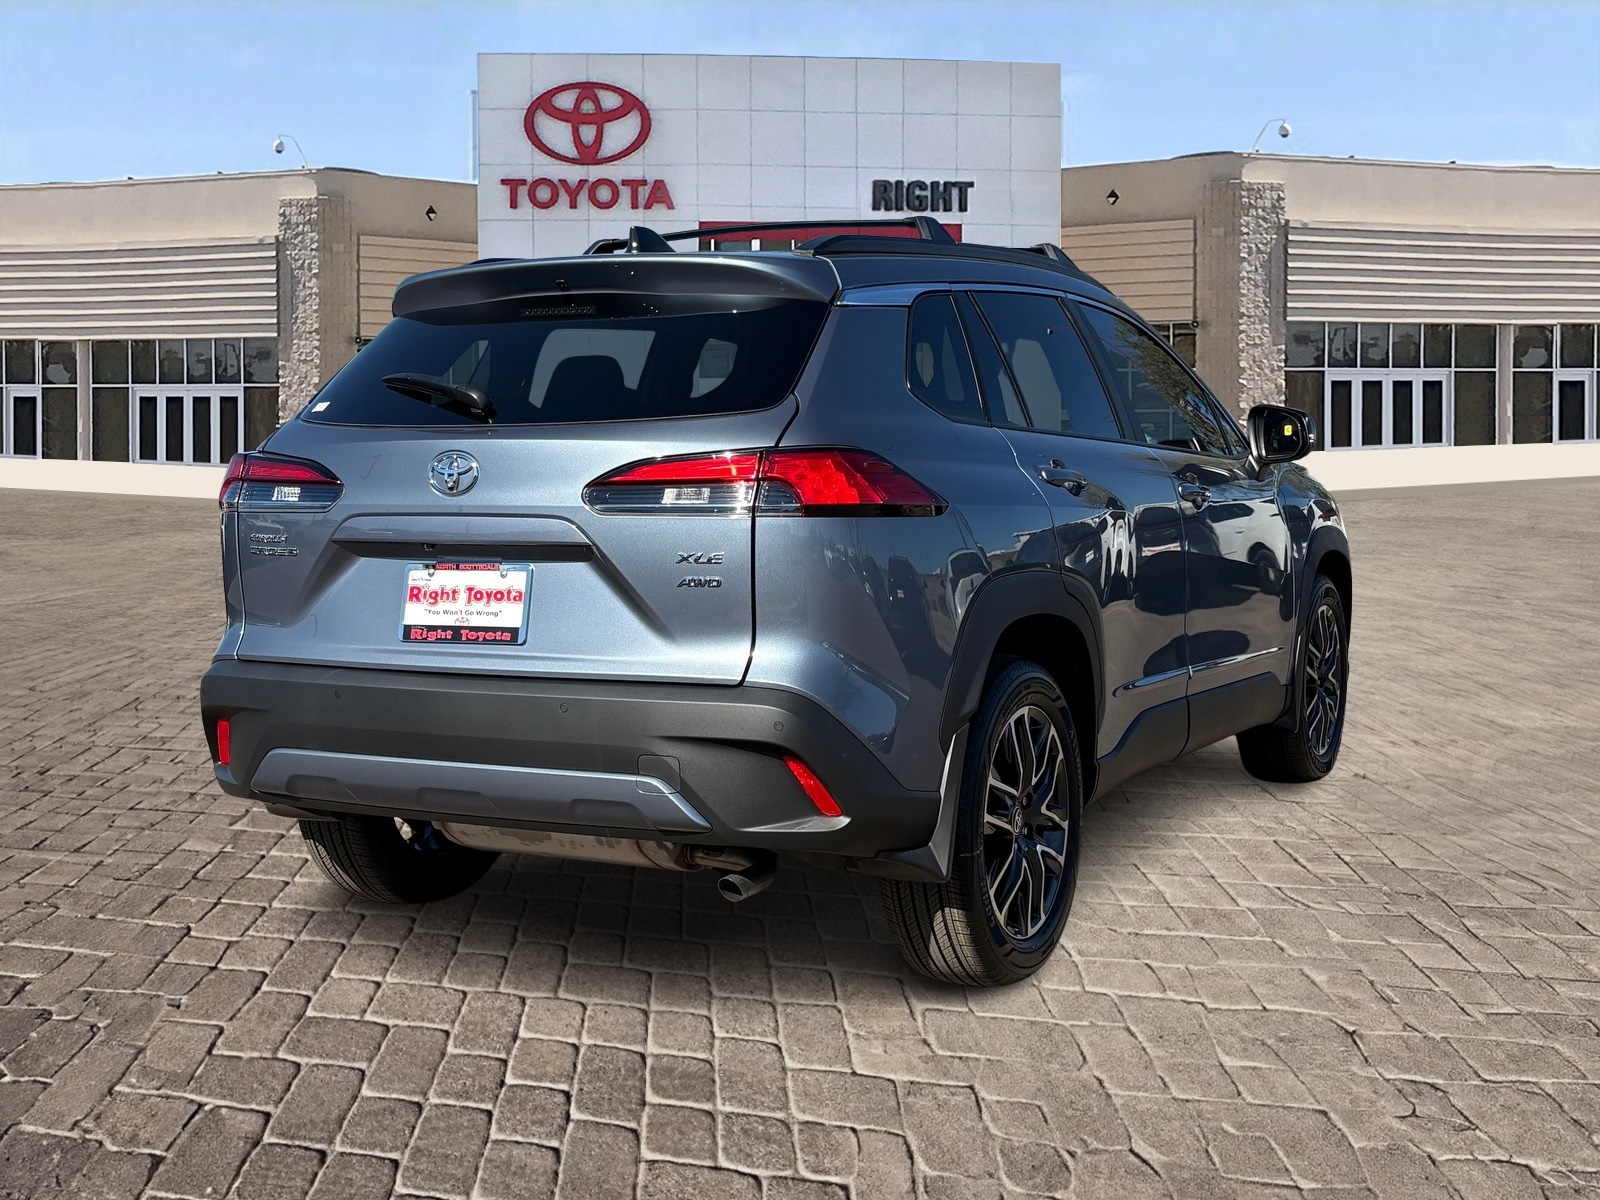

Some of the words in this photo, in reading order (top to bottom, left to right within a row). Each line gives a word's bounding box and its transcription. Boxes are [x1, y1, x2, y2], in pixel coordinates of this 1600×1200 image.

[500, 178, 675, 209] TOYOTA
[872, 180, 974, 212] RIGHT
[675, 551, 724, 564] XLE
[676, 577, 722, 588] AWD
[407, 585, 459, 606] Right
[465, 585, 524, 606] Toyota
[410, 628, 453, 641] Right
[461, 629, 512, 641] Toyota
